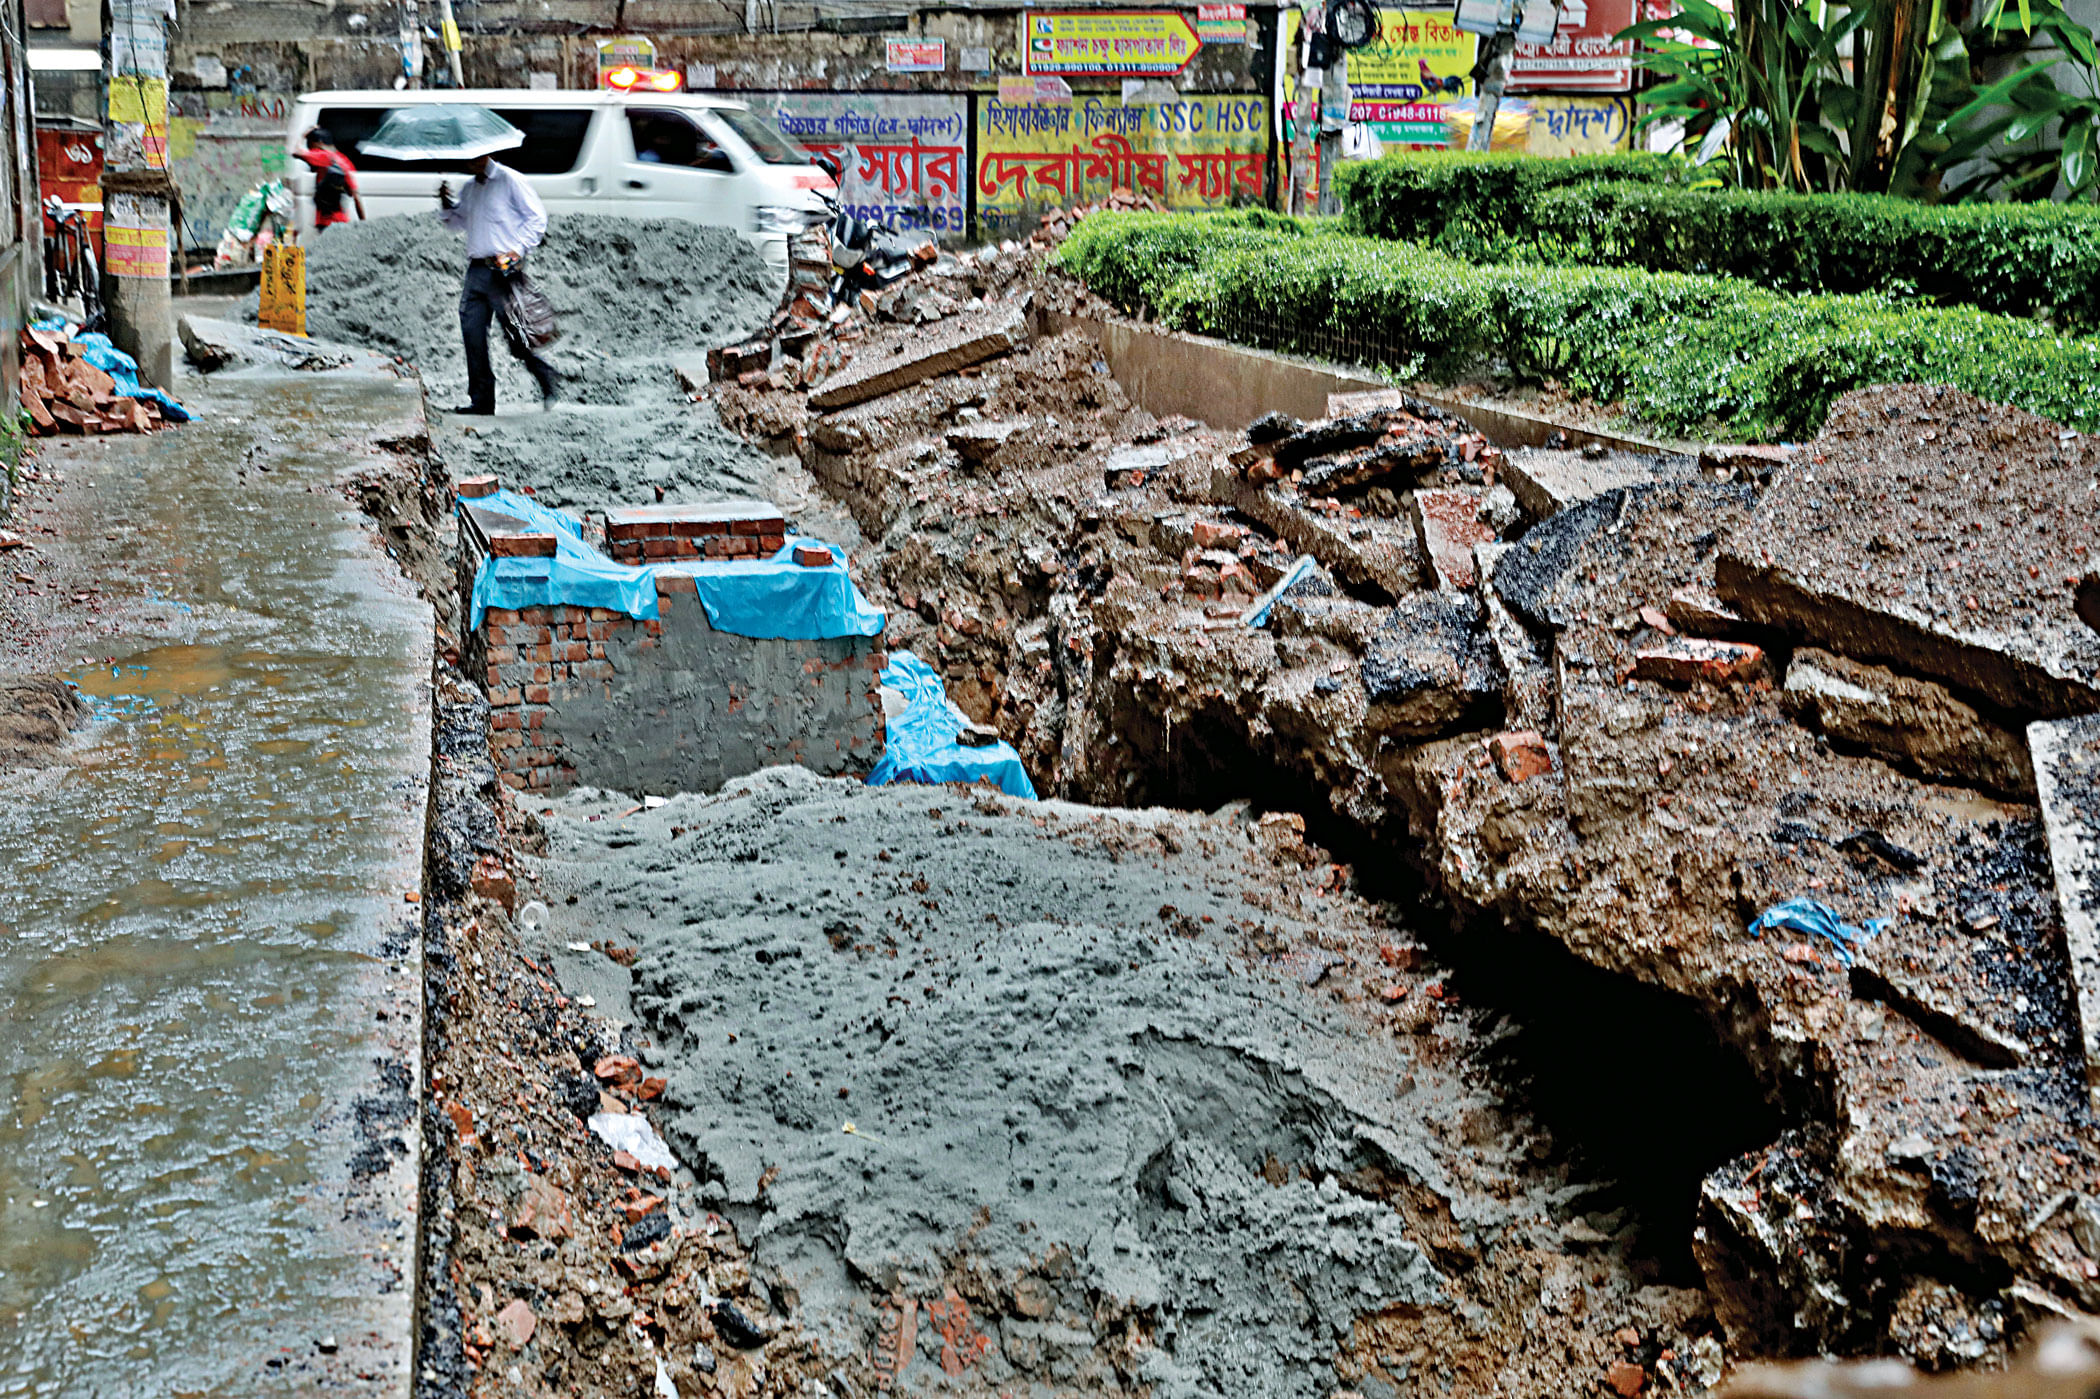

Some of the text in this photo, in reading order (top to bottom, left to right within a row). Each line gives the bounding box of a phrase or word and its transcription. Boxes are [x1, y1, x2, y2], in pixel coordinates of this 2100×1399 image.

[1056, 37, 1089, 57] ফ্যাশন
[1092, 38, 1111, 62] চক্ষু
[1113, 36, 1166, 59] হাসপাতাল
[778, 110, 830, 136] উচ্চতর
[1160, 101, 1203, 133] SSC
[1217, 100, 1263, 133] HSC
[855, 135, 964, 197] স্যার
[979, 133, 1169, 199] দেবাশীষ
[1175, 147, 1268, 198] স্যার
